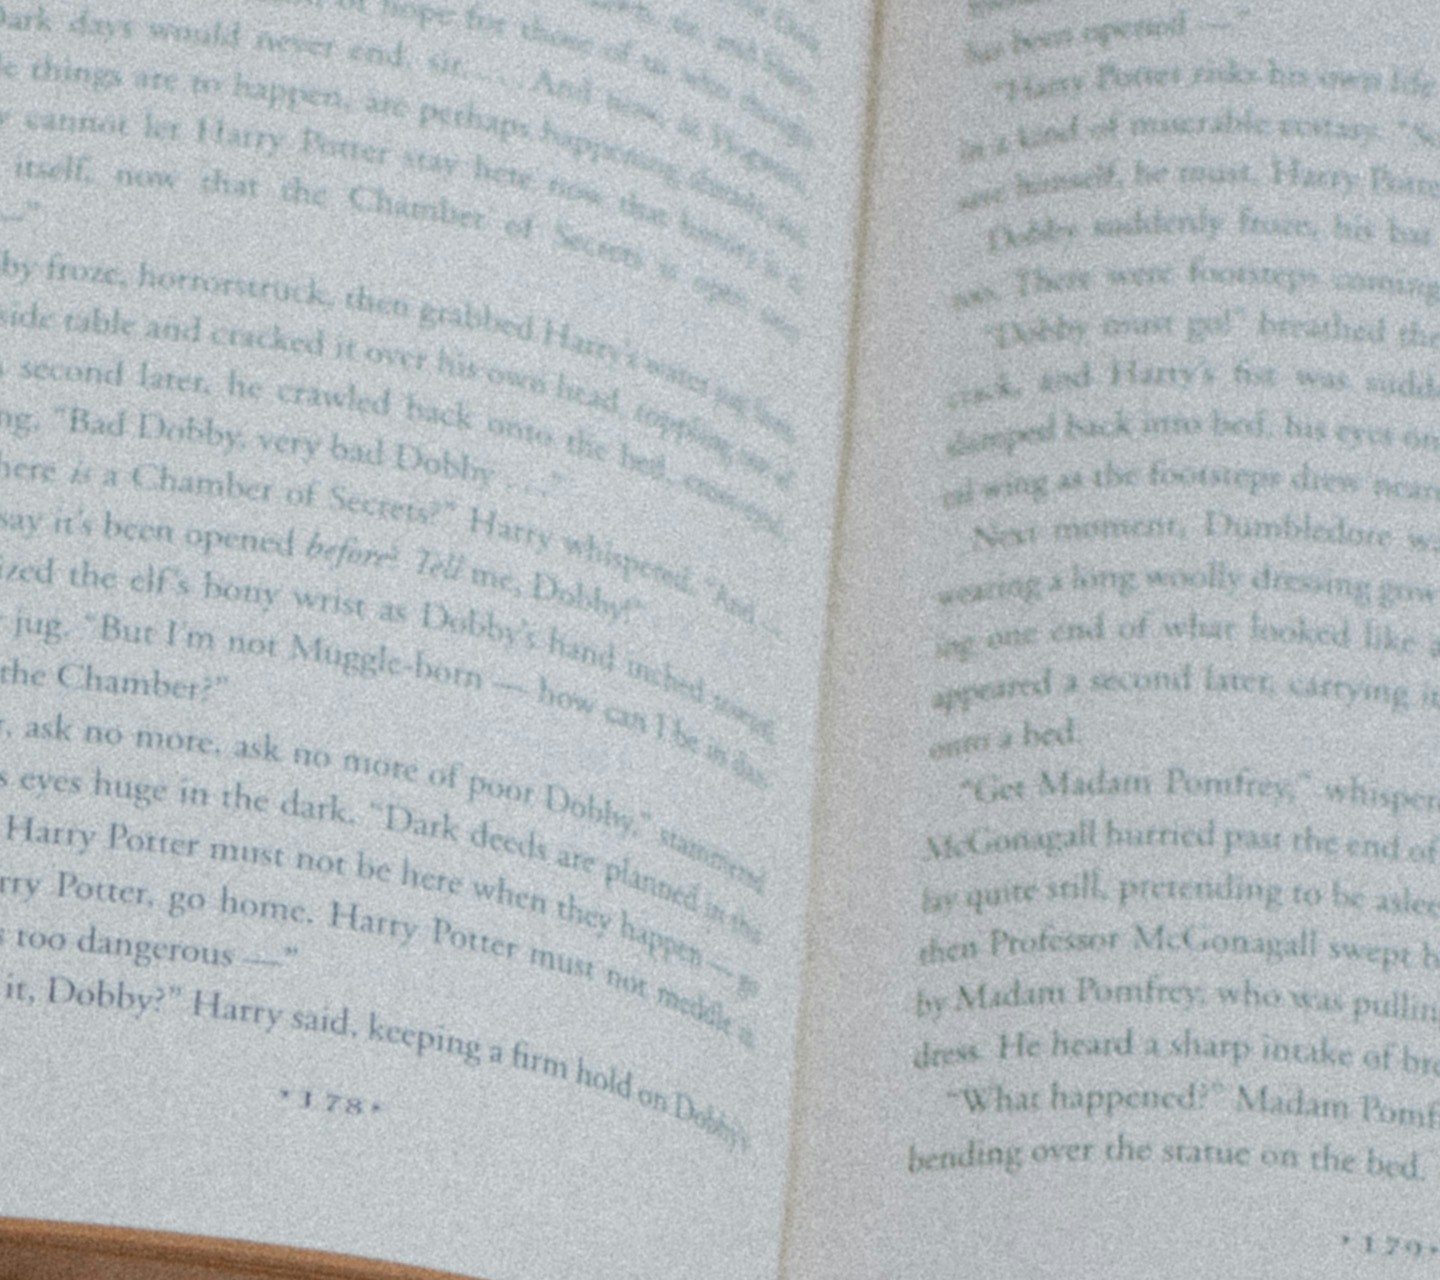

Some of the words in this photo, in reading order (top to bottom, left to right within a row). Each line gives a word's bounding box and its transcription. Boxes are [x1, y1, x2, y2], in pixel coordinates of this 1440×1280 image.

[22, 711, 72, 743] ask
[81, 723, 125, 747] no
[133, 727, 222, 757] more,
[231, 730, 282, 764] ask
[291, 744, 333, 768] no
[341, 751, 419, 784] more
[425, 761, 462, 790] of
[465, 772, 535, 806] poor
[14, 926, 69, 952] too
[73, 923, 235, 968] dangerous
[3, 971, 36, 1005] it,
[45, 973, 184, 1019] Dobby?”
[190, 987, 284, 1034] Harry
[289, 1005, 358, 1039] said,
[366, 1009, 483, 1067] keeping
[487, 1043, 505, 1065] a
[509, 1039, 569, 1080] firm
[573, 1054, 634, 1101] hold
[634, 1086, 669, 1113] on
[944, 1081, 1041, 1114] “What
[1234, 1083, 1351, 1121] Madam
[905, 1137, 1024, 1176] bending
[1029, 1141, 1095, 1164] over
[1102, 1130, 1153, 1163] the
[1161, 1142, 1251, 1167] statue
[1258, 1146, 1300, 1169] on
[1308, 1141, 1357, 1175] the
[1364, 1145, 1426, 1183] bed.
